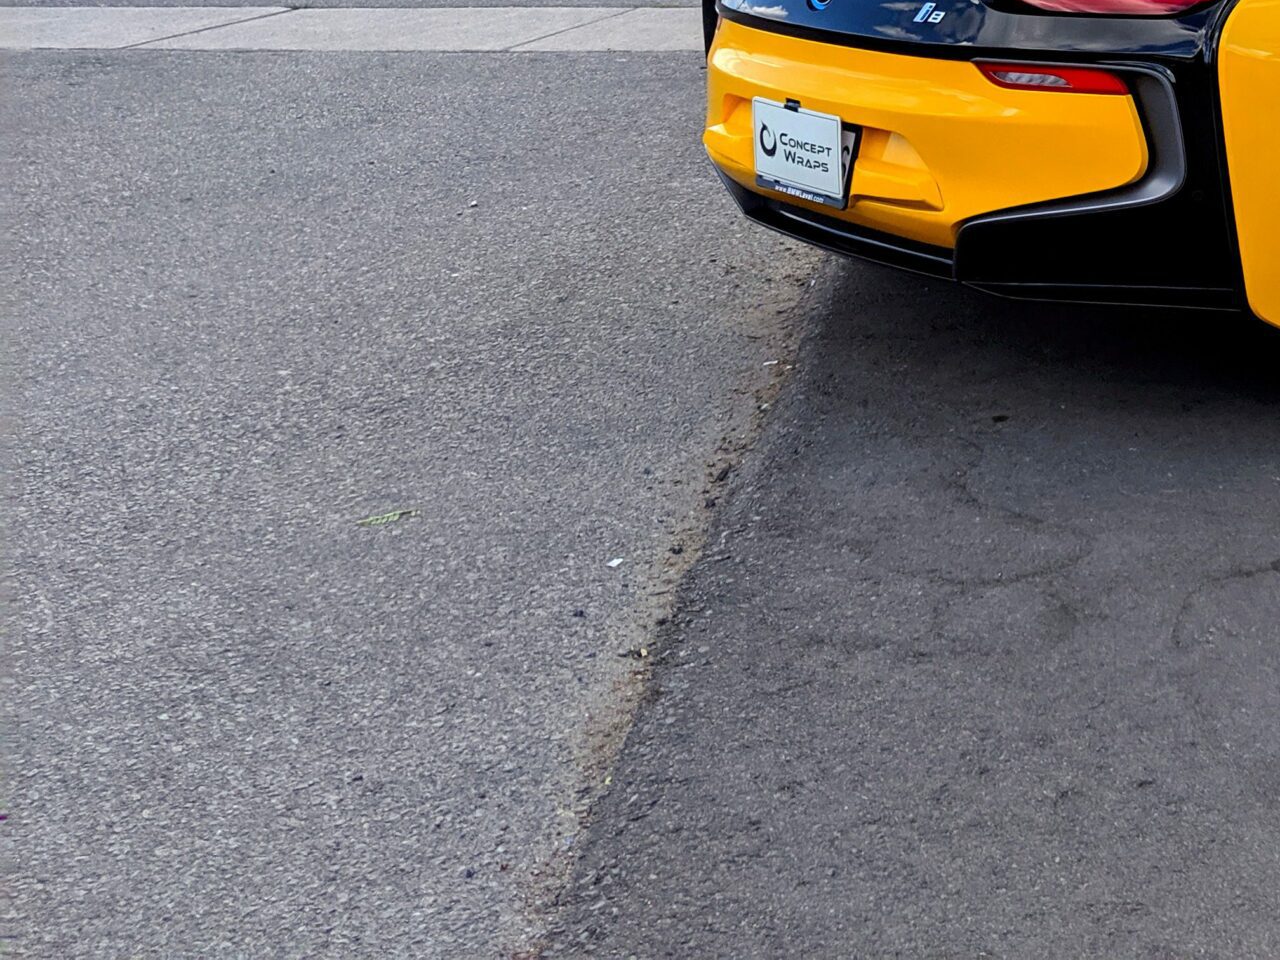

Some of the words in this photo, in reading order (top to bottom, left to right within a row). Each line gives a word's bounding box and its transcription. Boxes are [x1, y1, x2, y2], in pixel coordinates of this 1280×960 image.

[913, 2, 945, 23] i8
[779, 132, 832, 158] CONCEPT
[783, 148, 829, 173] WRAPS
